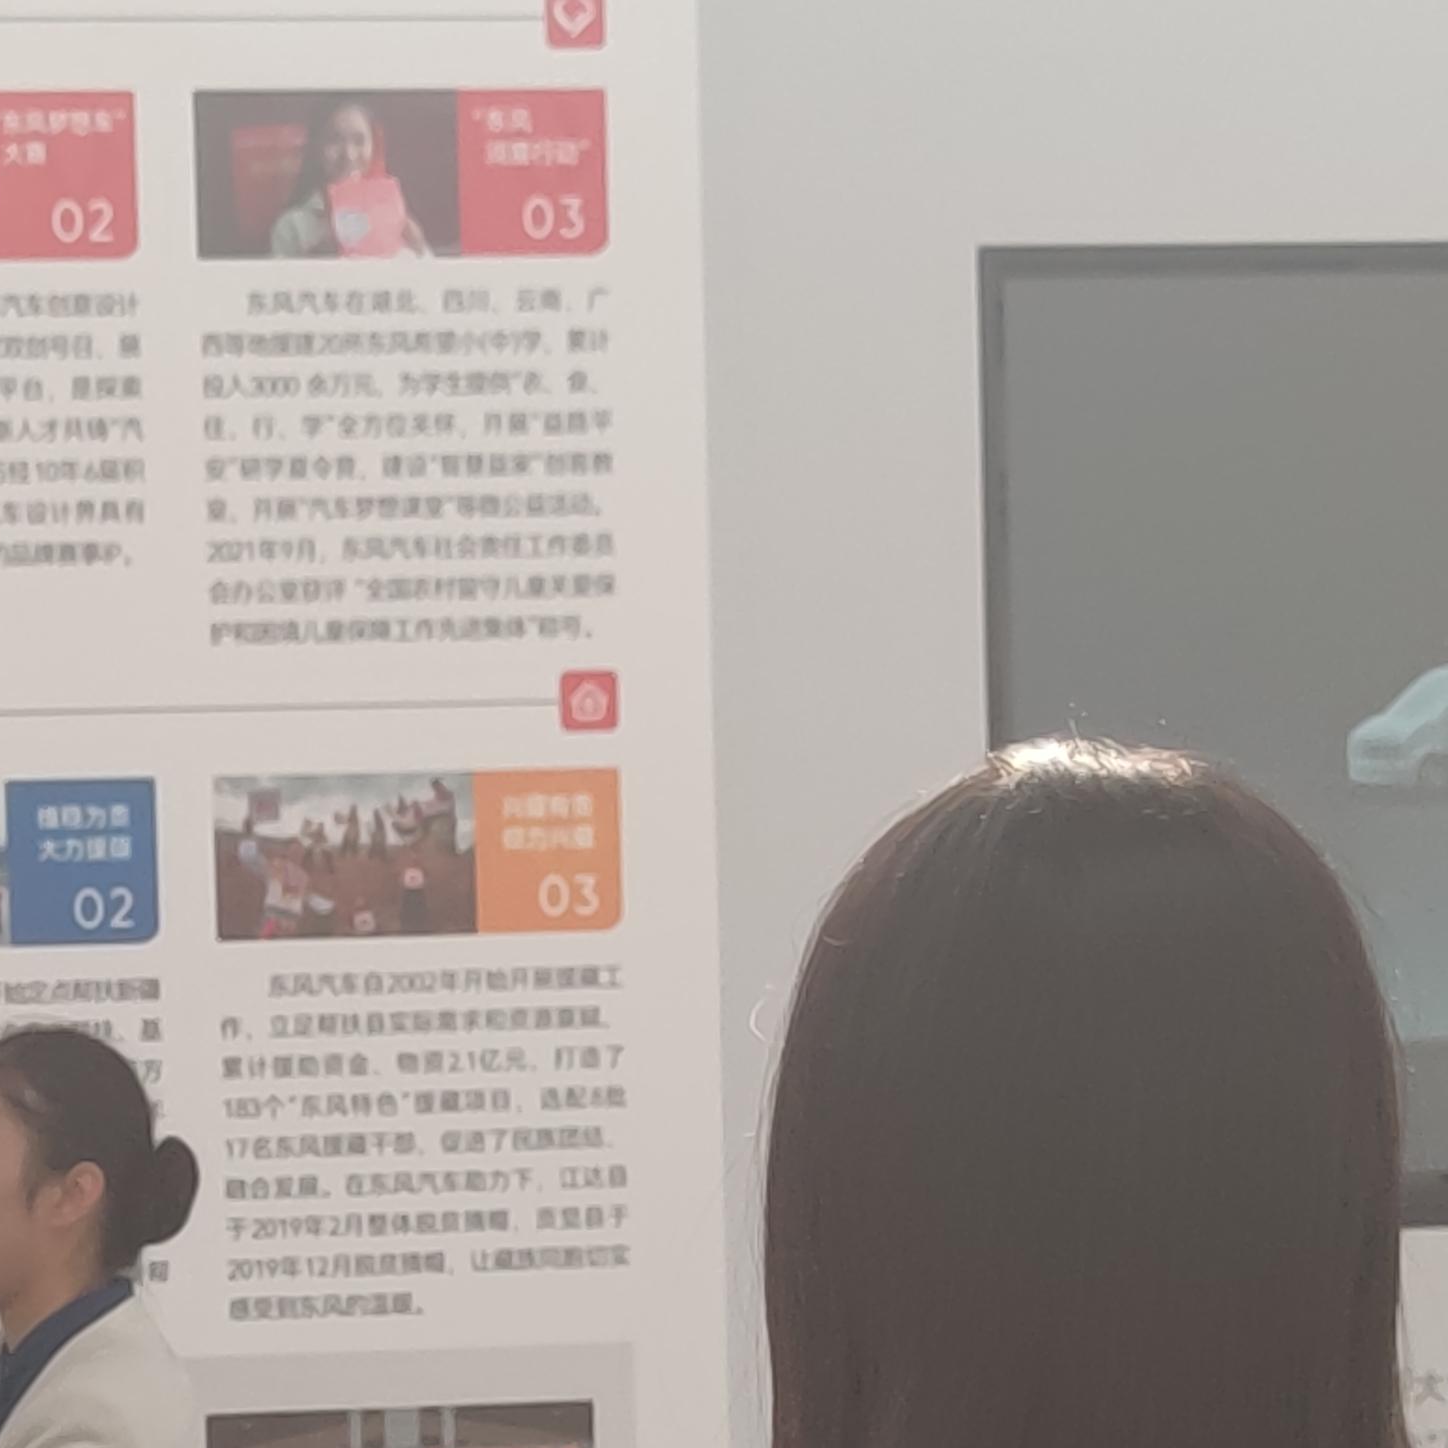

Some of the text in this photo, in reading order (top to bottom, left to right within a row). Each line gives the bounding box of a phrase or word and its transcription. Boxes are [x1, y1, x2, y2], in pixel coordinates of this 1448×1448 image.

[51, 199, 116, 244] 02
[522, 195, 586, 240] 03
[73, 886, 137, 930] 02
[537, 873, 601, 918] 03
